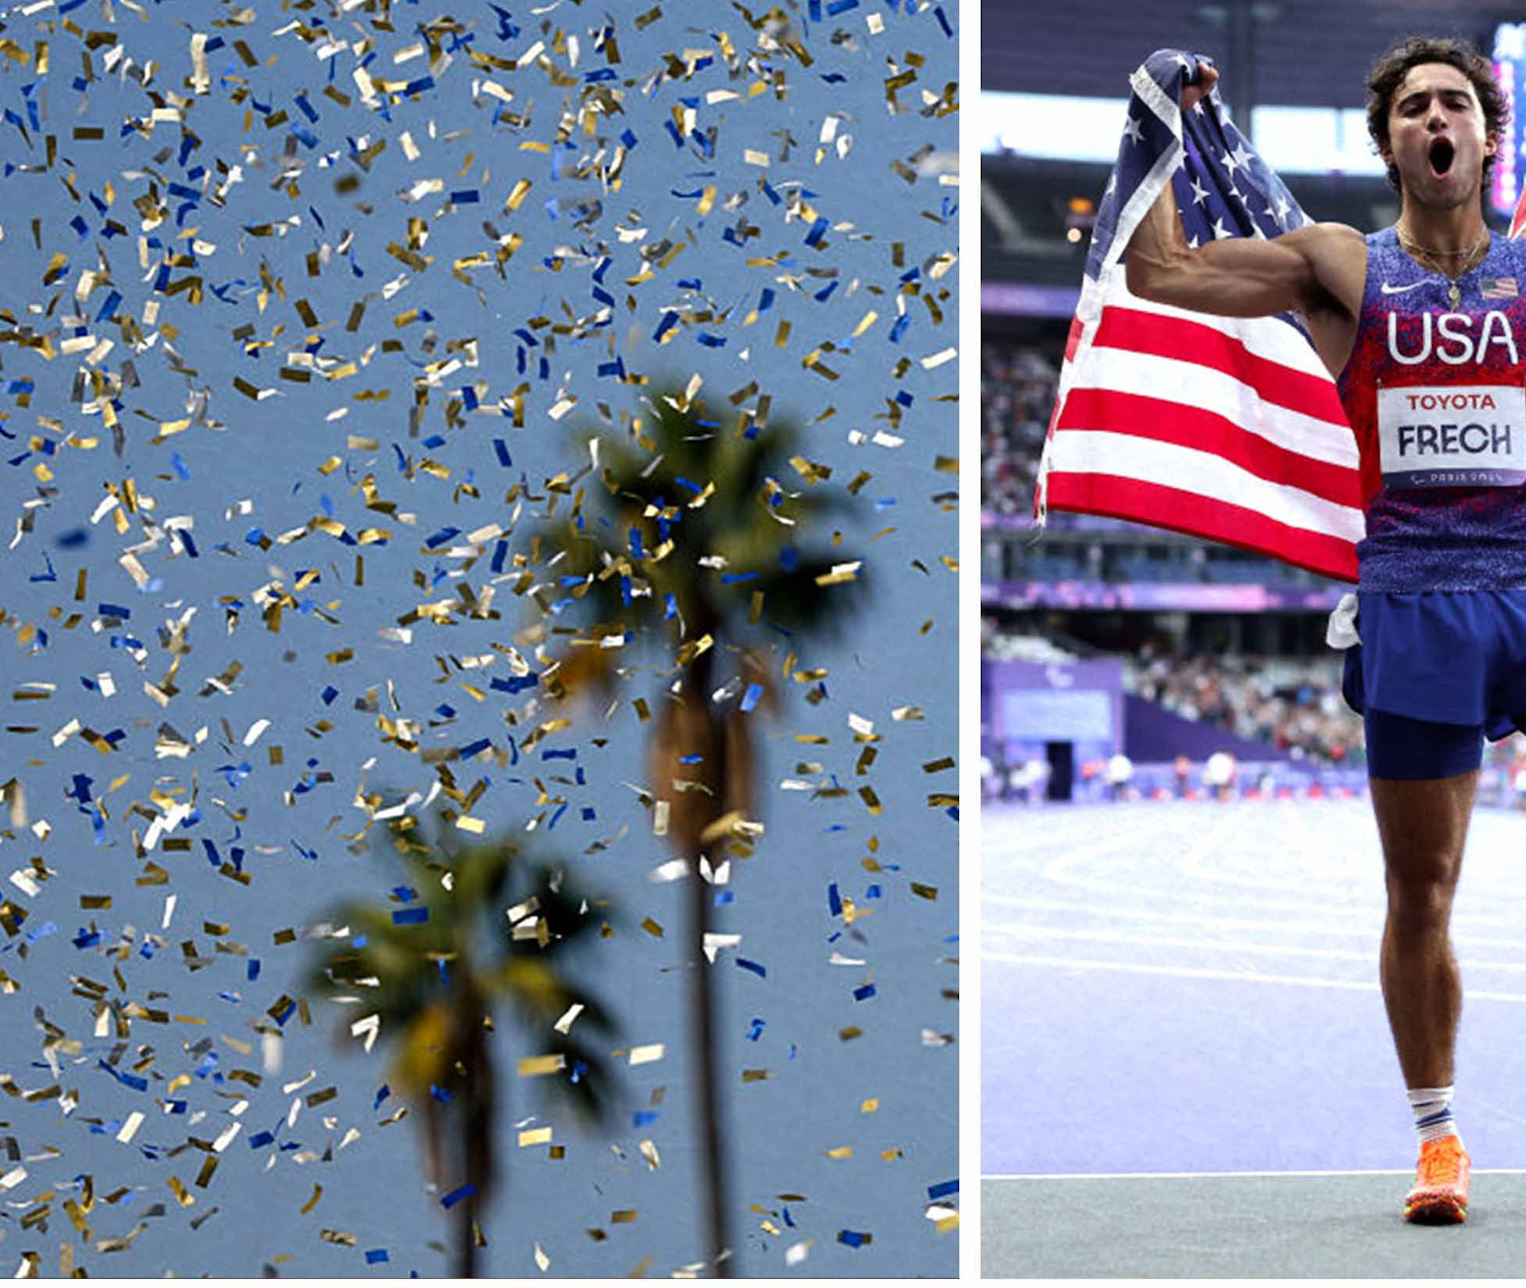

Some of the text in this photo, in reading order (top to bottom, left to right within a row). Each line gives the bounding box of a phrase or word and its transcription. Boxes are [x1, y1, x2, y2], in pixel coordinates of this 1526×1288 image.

[1388, 311, 1518, 365] USA
[1407, 395, 1496, 410] TOYOTA
[1398, 424, 1511, 456] FRECH
